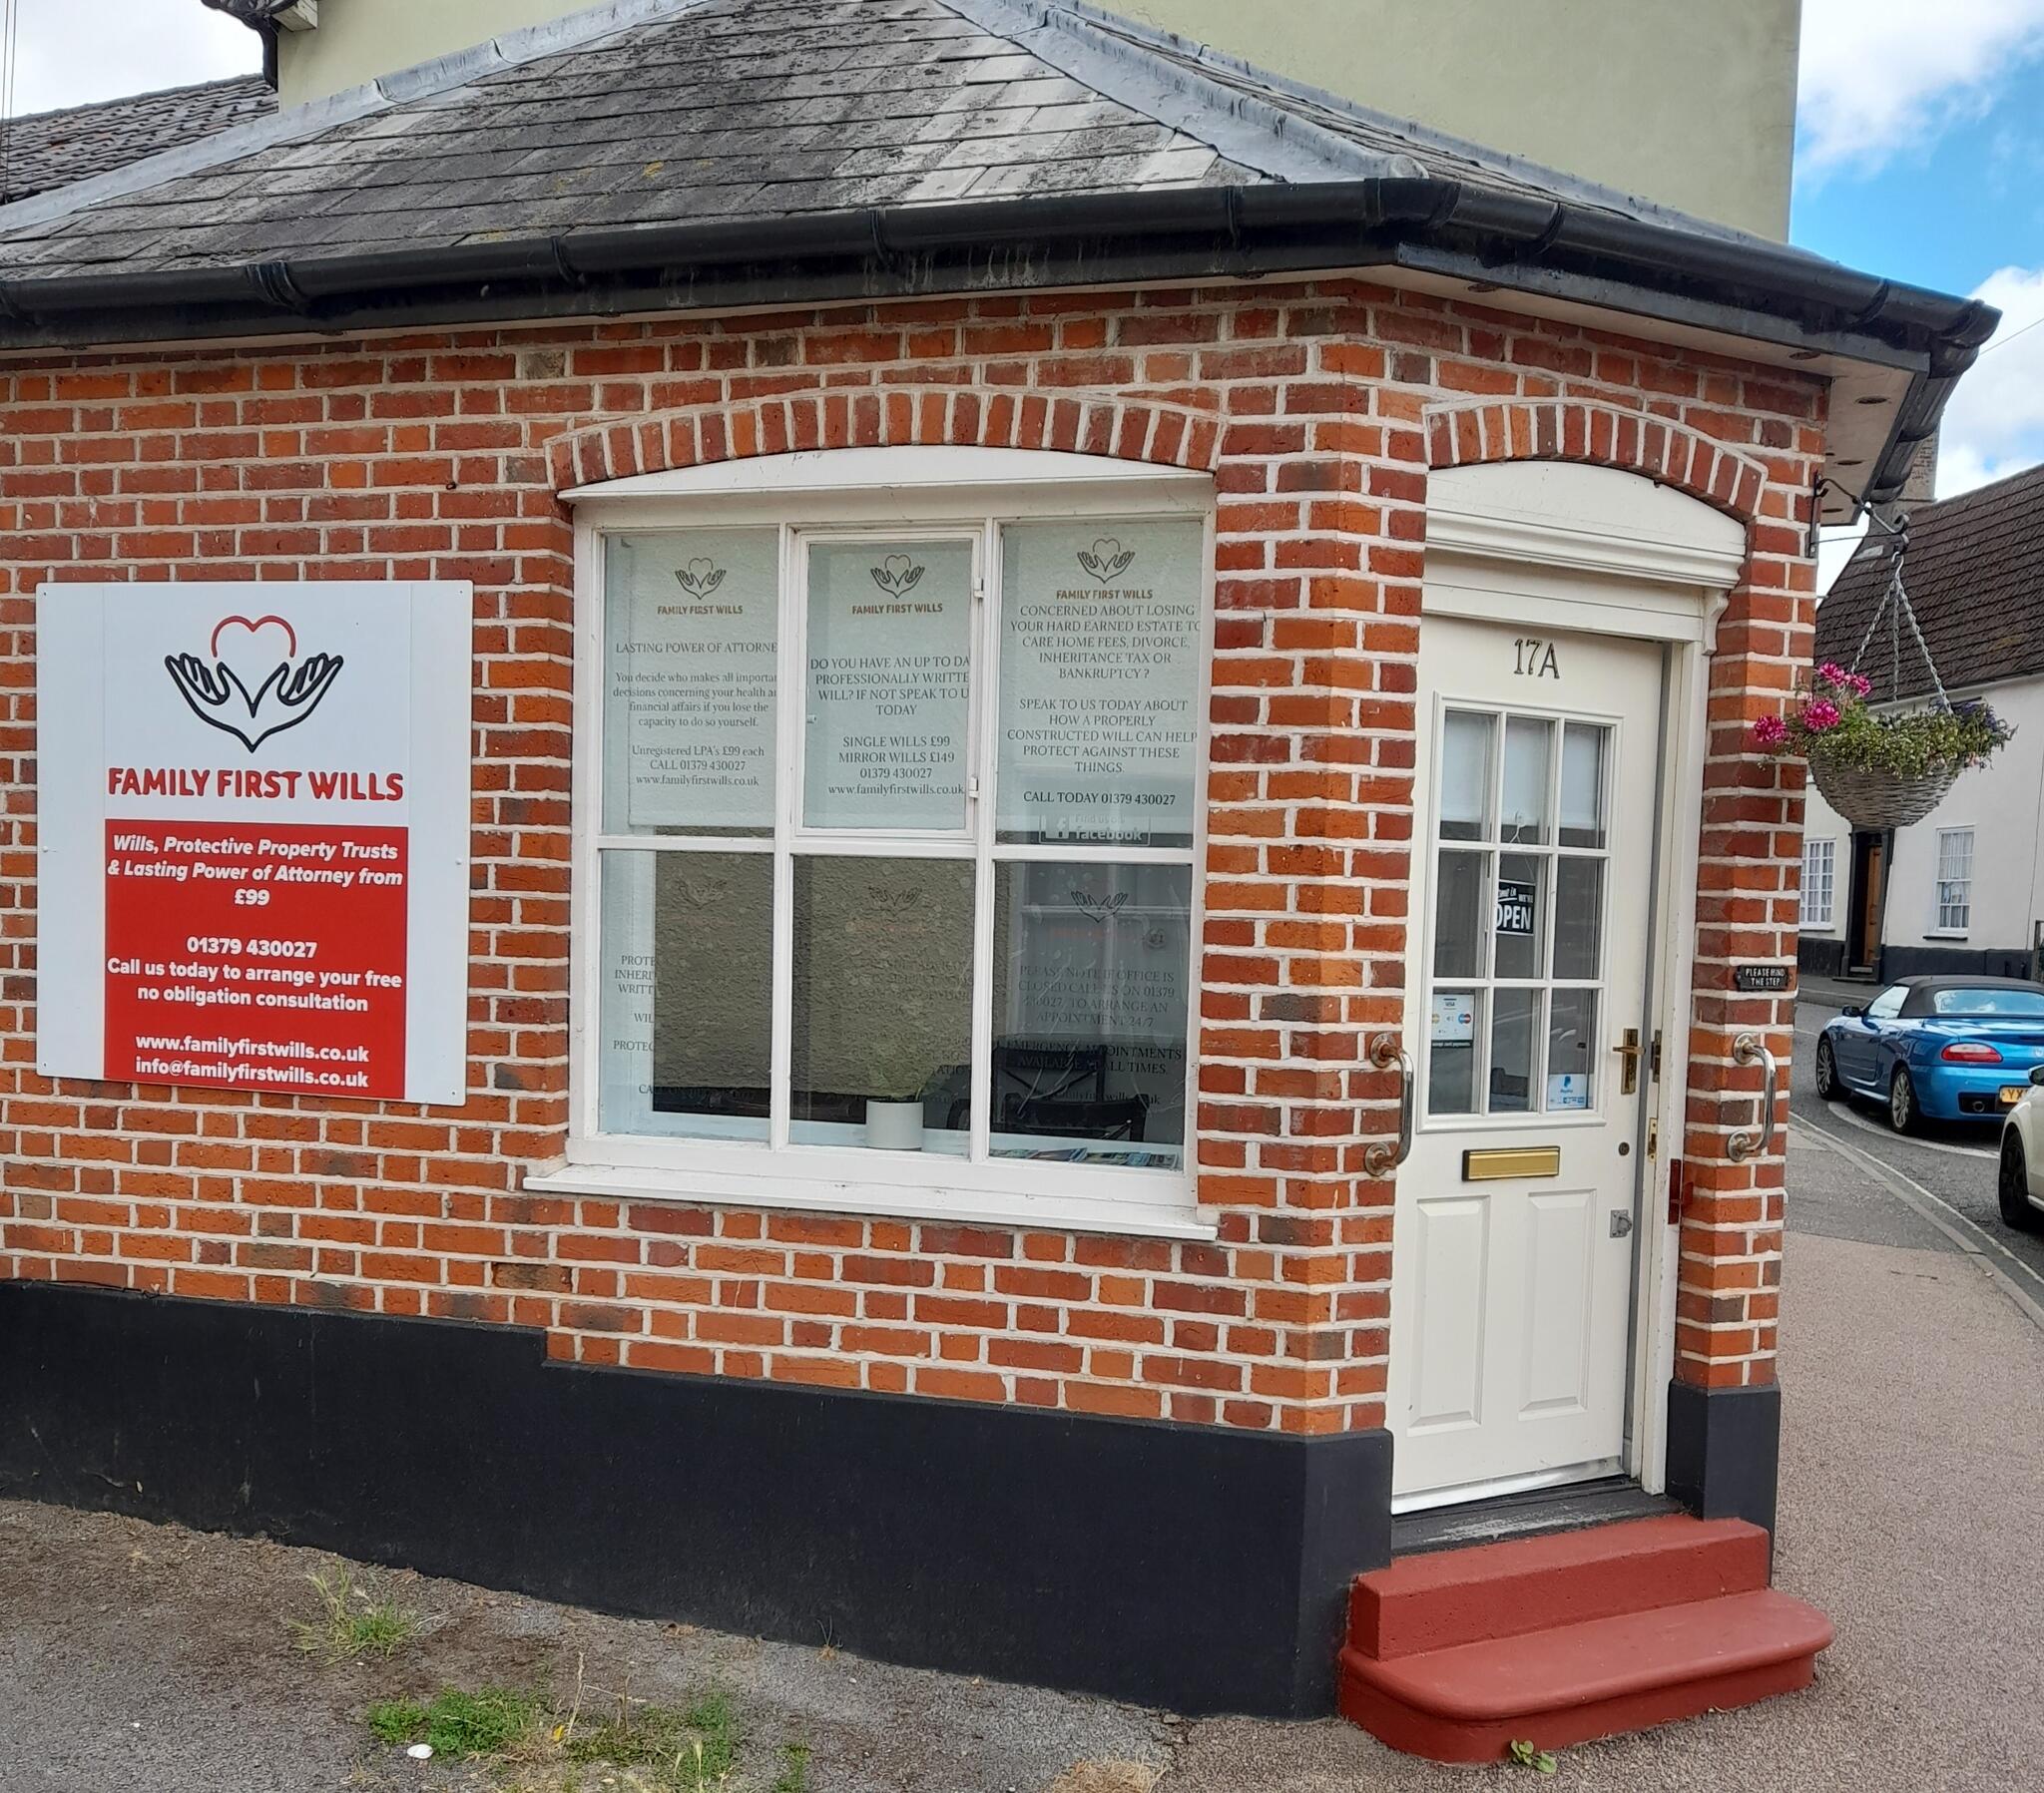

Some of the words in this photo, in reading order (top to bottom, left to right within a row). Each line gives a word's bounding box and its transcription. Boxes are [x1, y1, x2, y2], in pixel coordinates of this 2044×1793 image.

[1093, 590, 1120, 599] FIRST
[1123, 590, 1153, 599] WILLS
[658, 606, 688, 615] FAMILY
[690, 606, 714, 615] FIRST
[852, 605, 884, 615] FAMILY
[886, 604, 912, 614] FIRST
[915, 604, 942, 613] WILLS
[1020, 606, 1097, 616] CONCERNED
[1100, 606, 1142, 616] ABOUT
[1147, 606, 1195, 616] LOSING
[1011, 622, 1043, 632] YOUR
[1048, 622, 1081, 632] HARD
[1084, 622, 1133, 632] EARNED
[1137, 622, 1183, 631] ESTATE
[616, 643, 663, 654] LASTING
[666, 644, 705, 654] POWER
[708, 643, 722, 653] OF
[1022, 637, 1053, 647] CARE
[1057, 637, 1094, 647] HOME
[1098, 637, 1129, 649] FEES,
[1132, 638, 1190, 649] DIVORCE,
[810, 660, 828, 670] DO
[831, 659, 856, 669] YOU
[860, 658, 891, 669] HAVE
[893, 658, 911, 668] AN
[914, 658, 930, 668] UP
[933, 657, 951, 667] TO
[1039, 653, 1121, 663] INHERITANCE
[1126, 654, 1150, 663] TAX
[1153, 654, 1172, 663] OR
[1513, 639, 1560, 678] 17A
[616, 672, 633, 682] You
[636, 672, 665, 682] decide
[668, 672, 688, 682] who
[690, 672, 720, 682] makes
[723, 672, 733, 682] all
[816, 672, 920, 684] PROFESSIONALLY
[613, 687, 656, 696] decisions
[658, 687, 710, 699] concerning
[713, 689, 734, 698] your
[737, 687, 766, 697] health
[818, 689, 853, 699] WILL?
[856, 689, 867, 699] IF
[870, 689, 896, 699] NOT
[899, 689, 936, 699] SPEAK
[939, 688, 958, 698] TO
[629, 701, 669, 711] financial
[672, 701, 701, 711] affairs
[704, 701, 710, 711] if
[713, 703, 731, 713] you
[733, 702, 752, 711] lose
[754, 702, 768, 711] the
[875, 704, 917, 715] TODAY
[1020, 699, 1057, 709] SPEAK
[1061, 699, 1078, 709] TO
[1081, 699, 1096, 709] US
[1099, 699, 1142, 710] TODAY
[1142, 700, 1188, 710] ABOUT
[639, 716, 677, 728] capacity
[691, 716, 703, 725] do
[718, 717, 759, 728] yourself.
[1050, 715, 1080, 725] HOW
[1083, 715, 1091, 725] A
[1094, 715, 1156, 725] PROPERLY
[843, 736, 886, 746] SINGLE
[889, 736, 927, 746] WILLS
[930, 736, 950, 746] £99
[1007, 729, 1099, 741] CONSTRUCTED
[1102, 730, 1133, 741] WILL
[1136, 731, 1163, 742] CAN
[1166, 731, 1197, 742] HELP
[632, 745, 692, 757] Unregistered
[694, 745, 720, 755] LPA's
[723, 746, 741, 756] £99
[743, 746, 765, 756] each
[838, 752, 886, 762] MIRROR
[889, 752, 926, 762] WILLS
[930, 752, 954, 762] £149
[1023, 746, 1079, 756] PROTECT
[1082, 746, 1137, 757] AGAINST
[1140, 747, 1180, 758] THESE
[650, 760, 679, 769] CALL
[680, 760, 708, 770] 01379
[710, 761, 746, 770] 430027
[1075, 762, 1125, 772] THINGS.
[860, 768, 890, 778] 01379
[893, 768, 932, 778] 430027
[108, 768, 210, 796] FAMILY
[218, 770, 301, 798] FIRST
[308, 772, 403, 801] WILLS
[636, 774, 760, 786] www.familyfirstwills.co.uk
[1023, 791, 1054, 802] CALL
[1057, 792, 1099, 803] TODAY
[1101, 793, 1132, 804] 01379
[1135, 794, 1175, 805] 430027
[114, 834, 160, 854] Wills,
[164, 836, 254, 855] Protective
[257, 839, 337, 861] Property
[341, 842, 398, 860] Trusts
[108, 859, 120, 876] &
[124, 860, 188, 881] Lasting
[192, 862, 249, 880] Power
[253, 864, 272, 880] of
[273, 865, 355, 887] Attorney
[359, 868, 403, 886] from
[234, 888, 270, 906] £99
[1496, 903, 1531, 929] OPEN
[187, 936, 242, 954] 01379
[247, 939, 317, 958] 430027
[108, 958, 140, 975] Call
[145, 962, 166, 976] us
[169, 962, 219, 982] today
[223, 964, 242, 980] to
[246, 966, 315, 987] arrange
[319, 971, 359, 988] your
[365, 970, 402, 988] free
[1117, 970, 1160, 982] OFFICE
[1163, 972, 1174, 983] IS
[1771, 968, 1785, 977] MIND
[1144, 986, 1175, 997] 01379
[138, 986, 160, 1000] no
[164, 986, 252, 1006] obligation
[256, 992, 368, 1012] consultation
[1150, 1003, 1168, 1013] AN
[136, 1034, 369, 1063] www.familyfirstwills.co.uk
[136, 1057, 369, 1088] info@familyfirstwills.co.uk
[2008, 1090, 2028, 1100] YX
